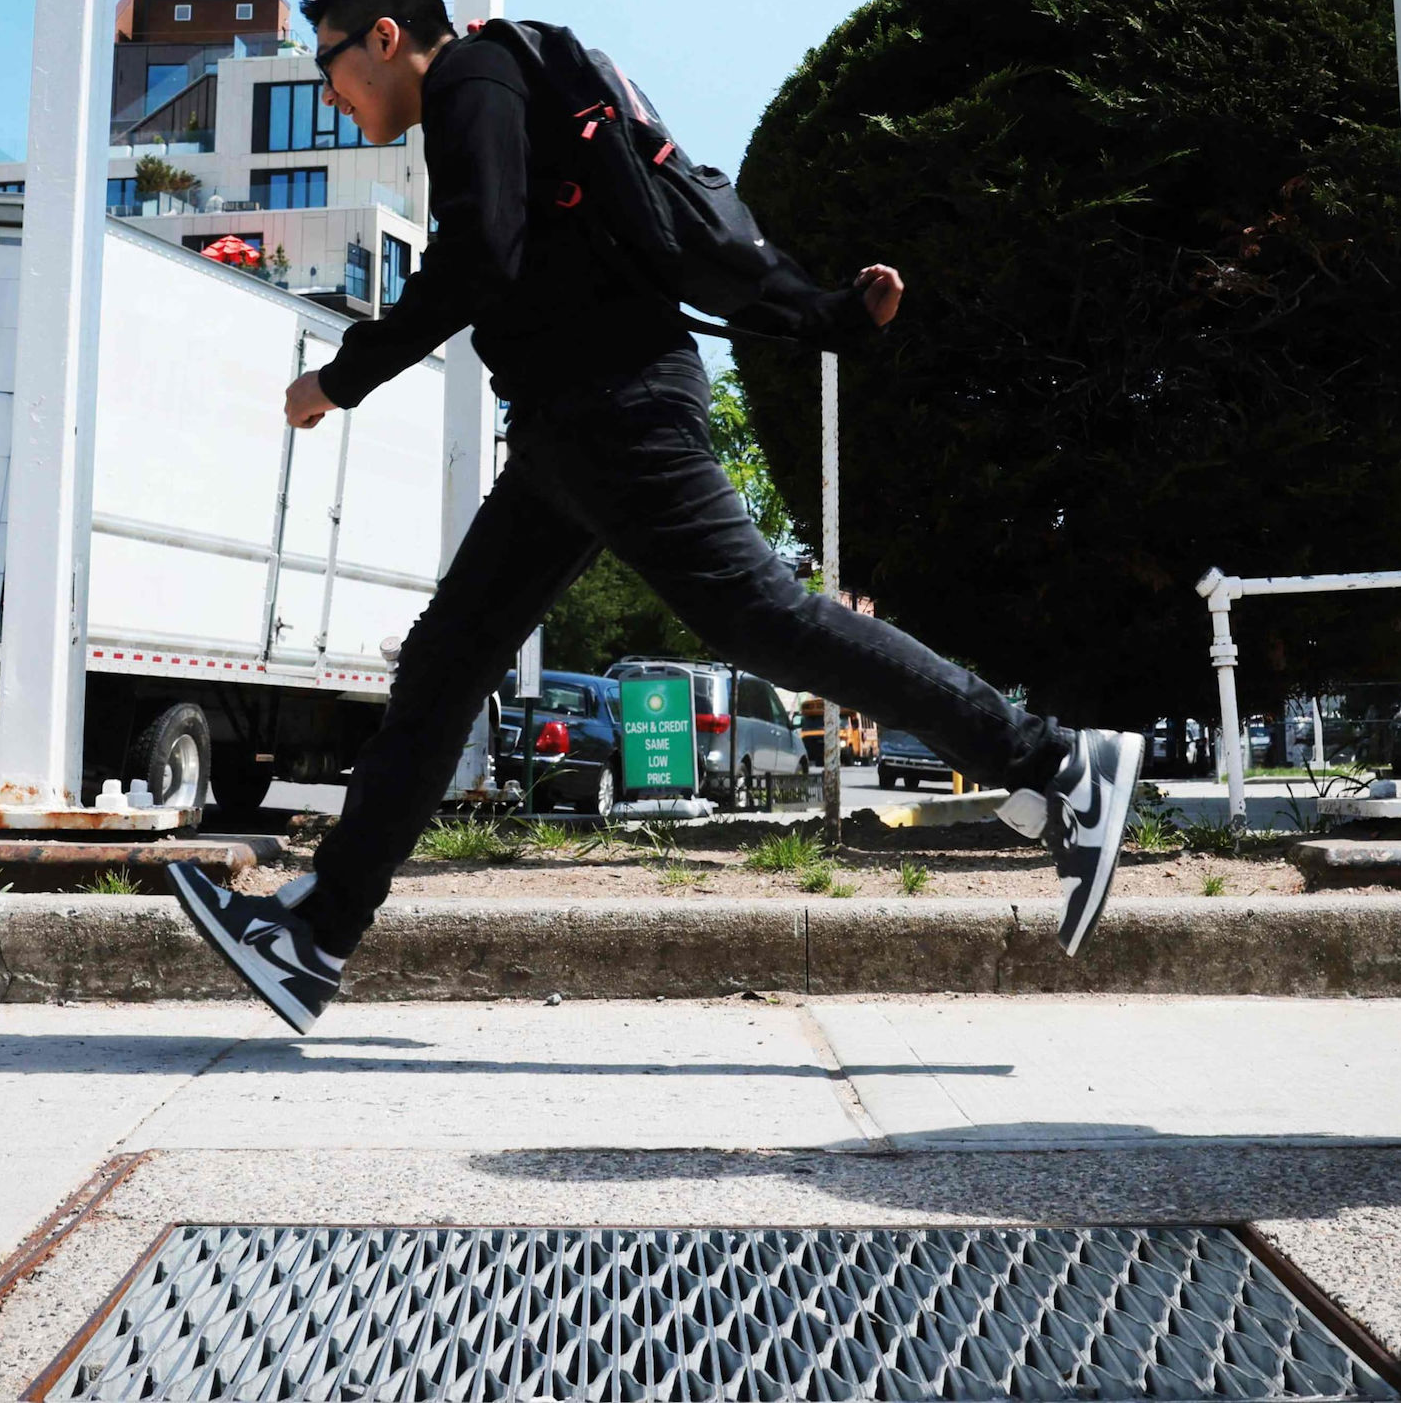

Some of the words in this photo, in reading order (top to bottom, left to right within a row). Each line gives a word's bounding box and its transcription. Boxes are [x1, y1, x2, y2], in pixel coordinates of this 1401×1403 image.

[625, 721, 648, 733] CASH
[650, 721, 657, 733] &
[658, 720, 688, 733] CREDIT
[645, 738, 670, 750] SAME
[648, 755, 668, 767] LOW
[647, 772, 671, 785] PRICE
